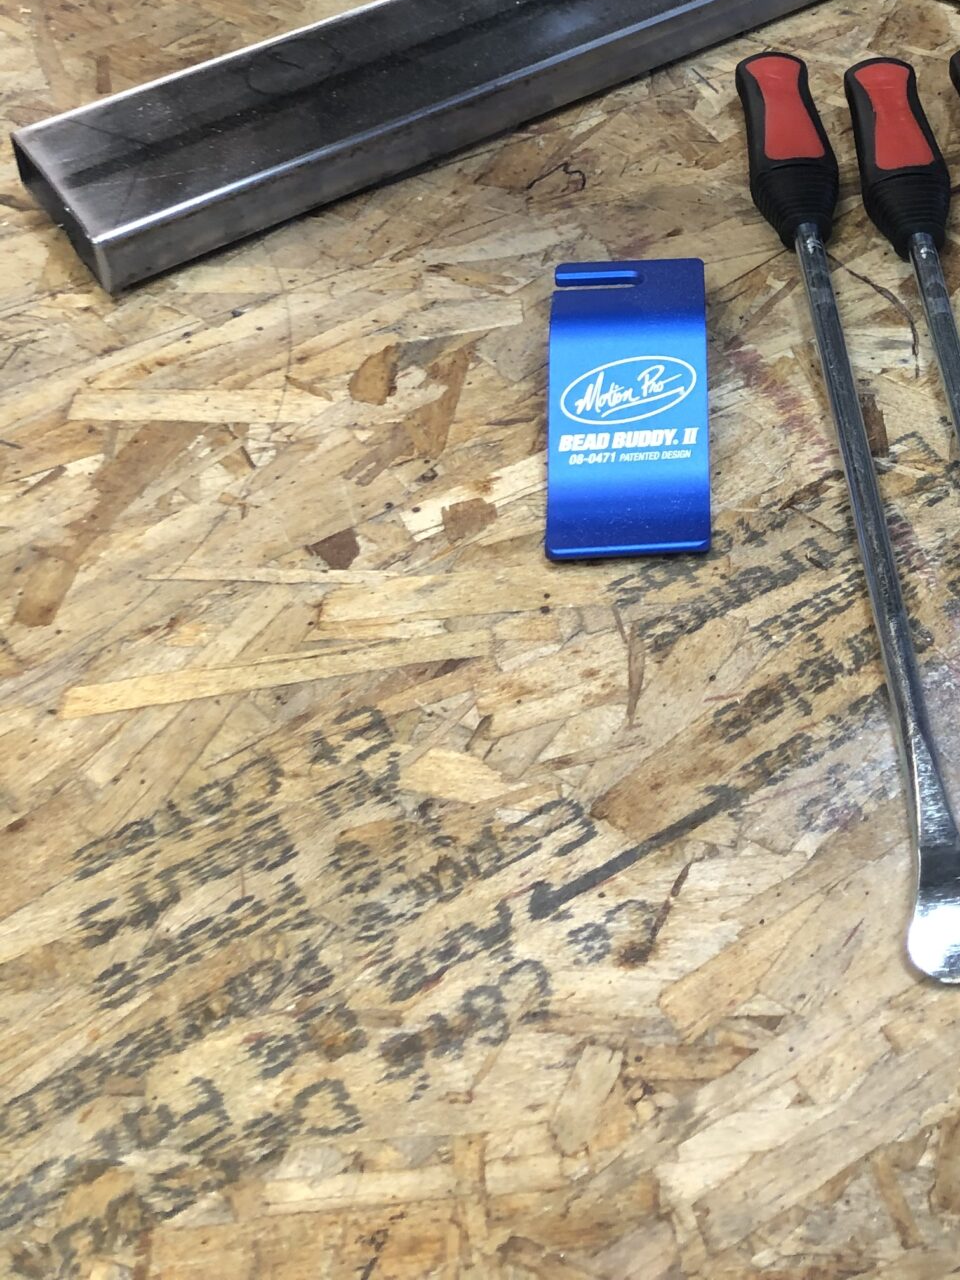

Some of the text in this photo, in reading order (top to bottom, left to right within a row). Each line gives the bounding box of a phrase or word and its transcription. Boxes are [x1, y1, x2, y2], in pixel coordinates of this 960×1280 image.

[575, 365, 683, 415] Motion Pro
[559, 433, 611, 453] BEAD
[568, 449, 692, 465] 08-0471 PATENTED DESIGN
